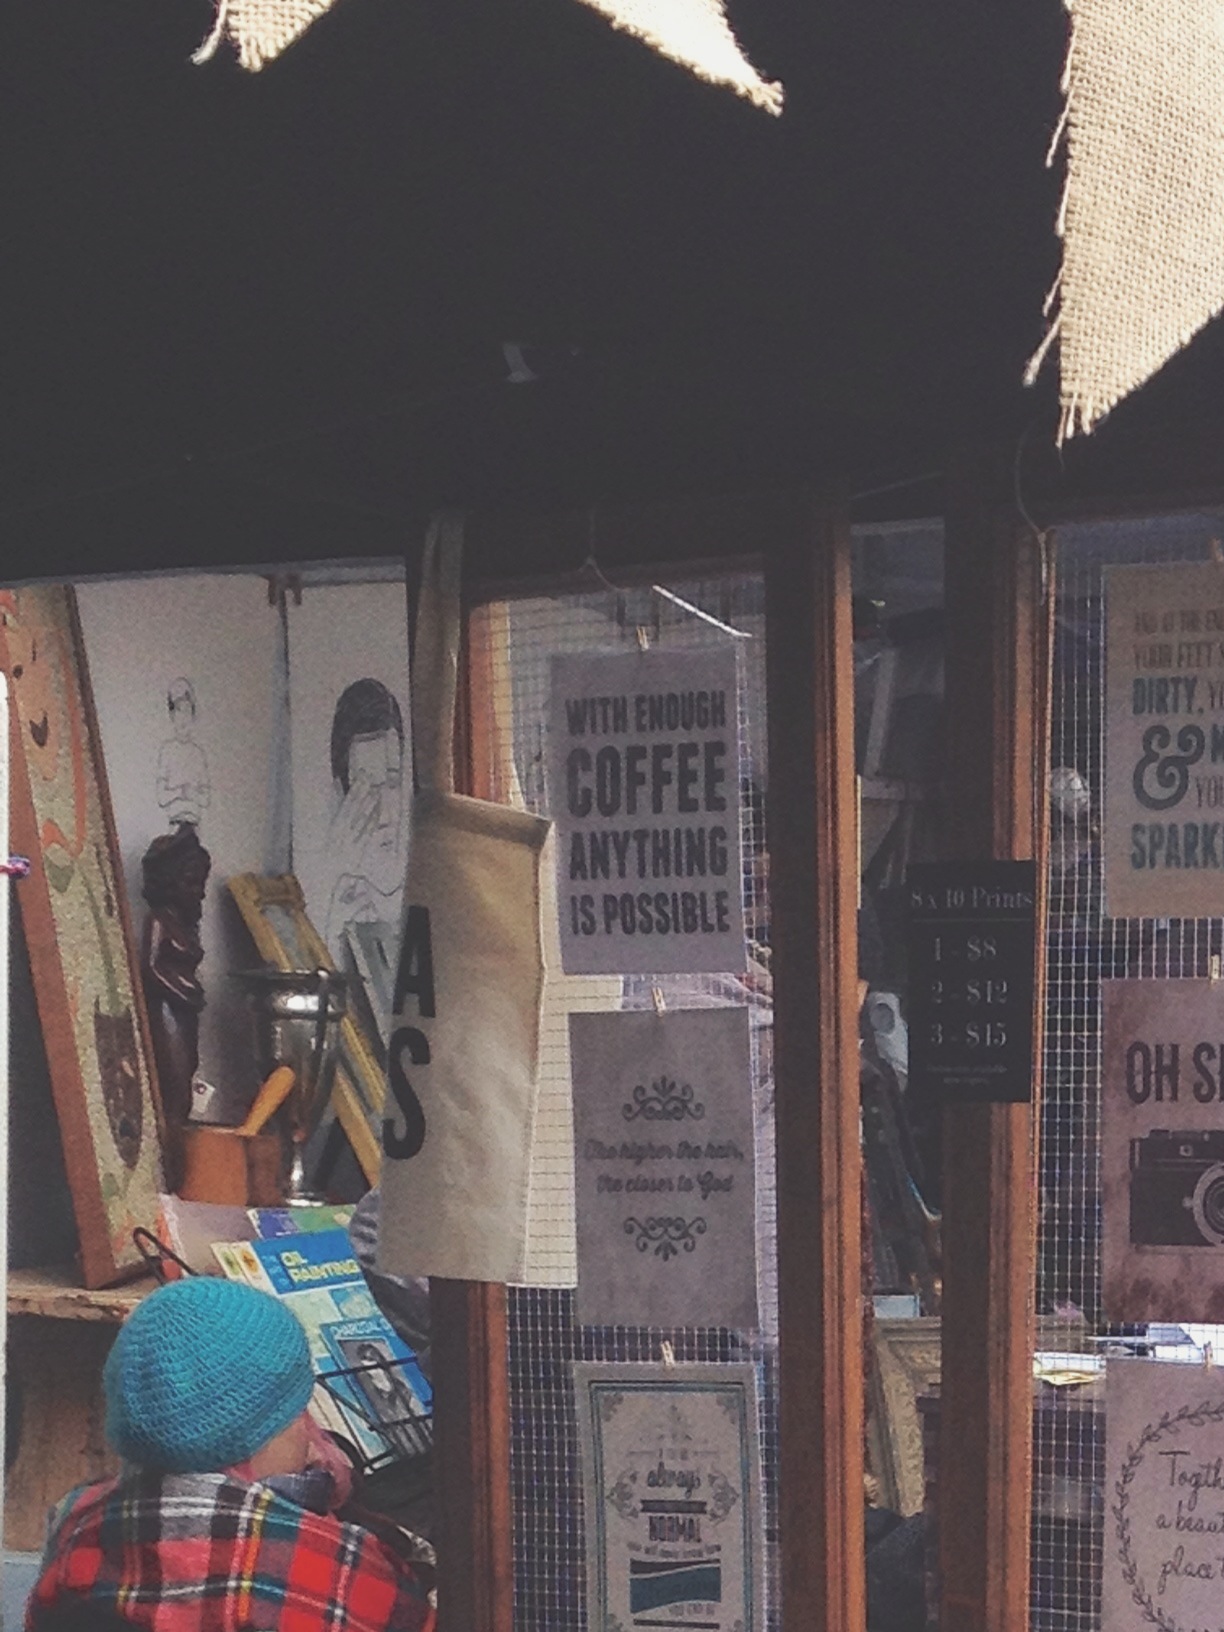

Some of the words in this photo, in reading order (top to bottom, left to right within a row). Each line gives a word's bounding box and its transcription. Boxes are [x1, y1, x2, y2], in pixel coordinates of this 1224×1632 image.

[565, 695, 626, 735] WITH
[636, 690, 727, 733] ENOUGH
[566, 741, 727, 818] COFFEE
[569, 826, 728, 880] ANYTHING
[571, 894, 596, 936] IS
[604, 890, 730, 934] POSSIBLE
[972, 886, 1033, 909] Prints
[1125, 1040, 1181, 1105] OH
[1156, 1515, 1170, 1531] a
[1157, 1546, 1215, 1595] place
